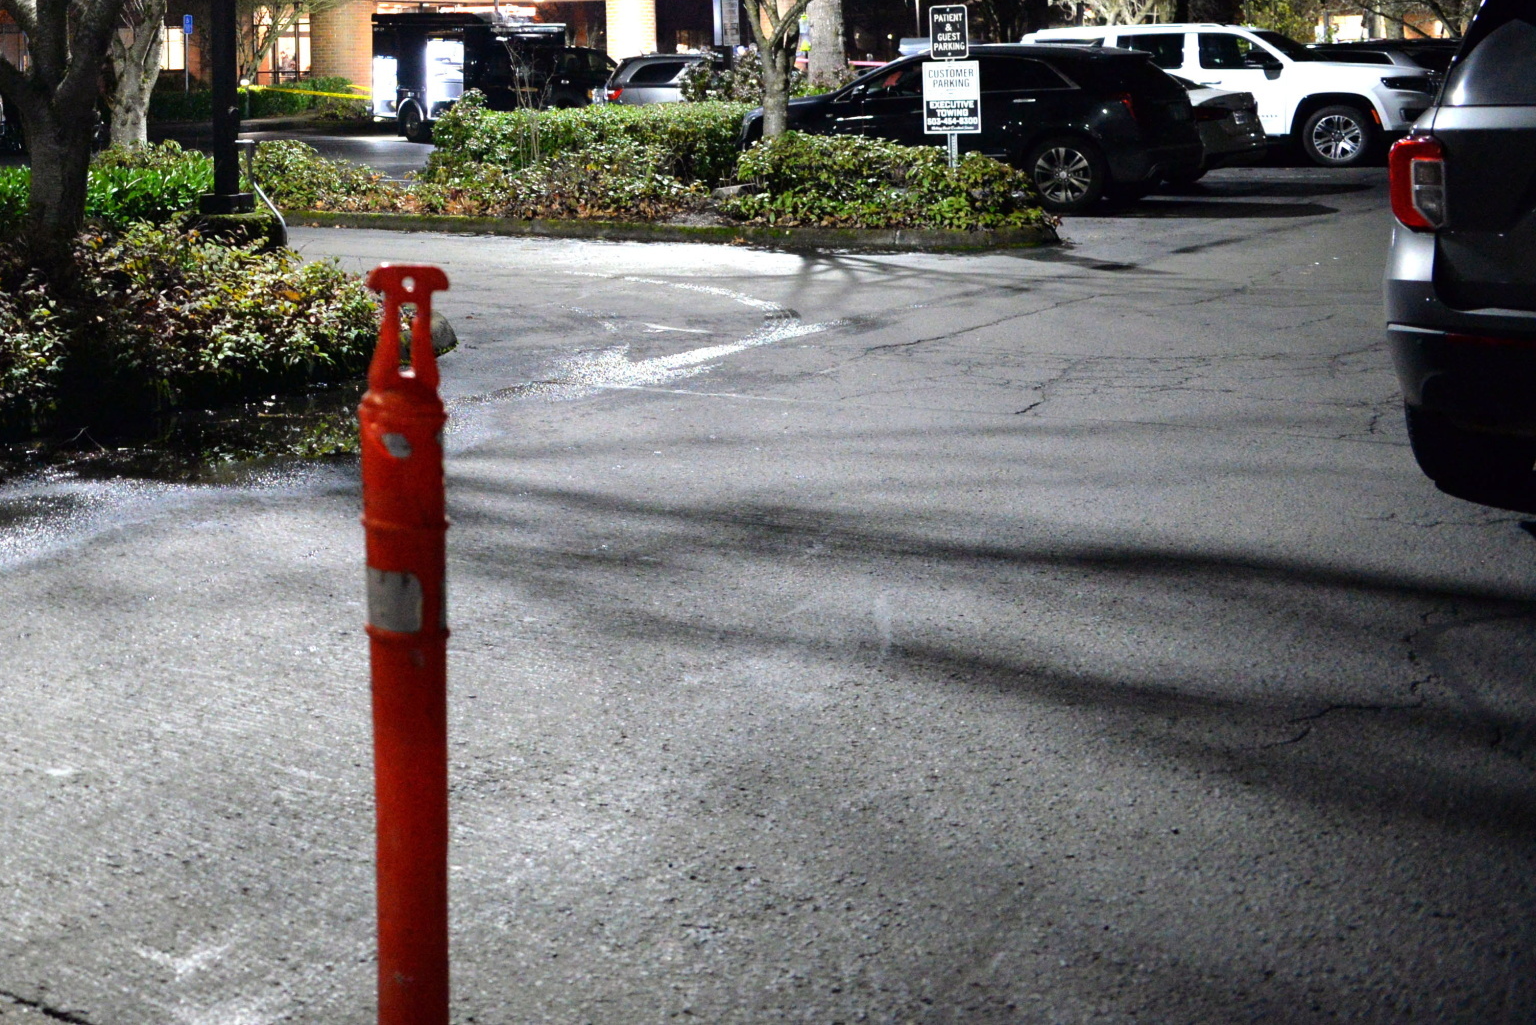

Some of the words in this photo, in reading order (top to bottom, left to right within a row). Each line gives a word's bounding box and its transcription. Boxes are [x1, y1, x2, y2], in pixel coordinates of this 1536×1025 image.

[933, 12, 963, 23] PATIENT
[945, 23, 953, 31] &
[937, 32, 961, 42] GUEST
[933, 41, 966, 51] PARKING
[928, 68, 974, 79] CUSTOMER
[932, 78, 970, 88] PARKING
[929, 100, 975, 109] EXECUTIVE
[935, 108, 969, 117] TOWING
